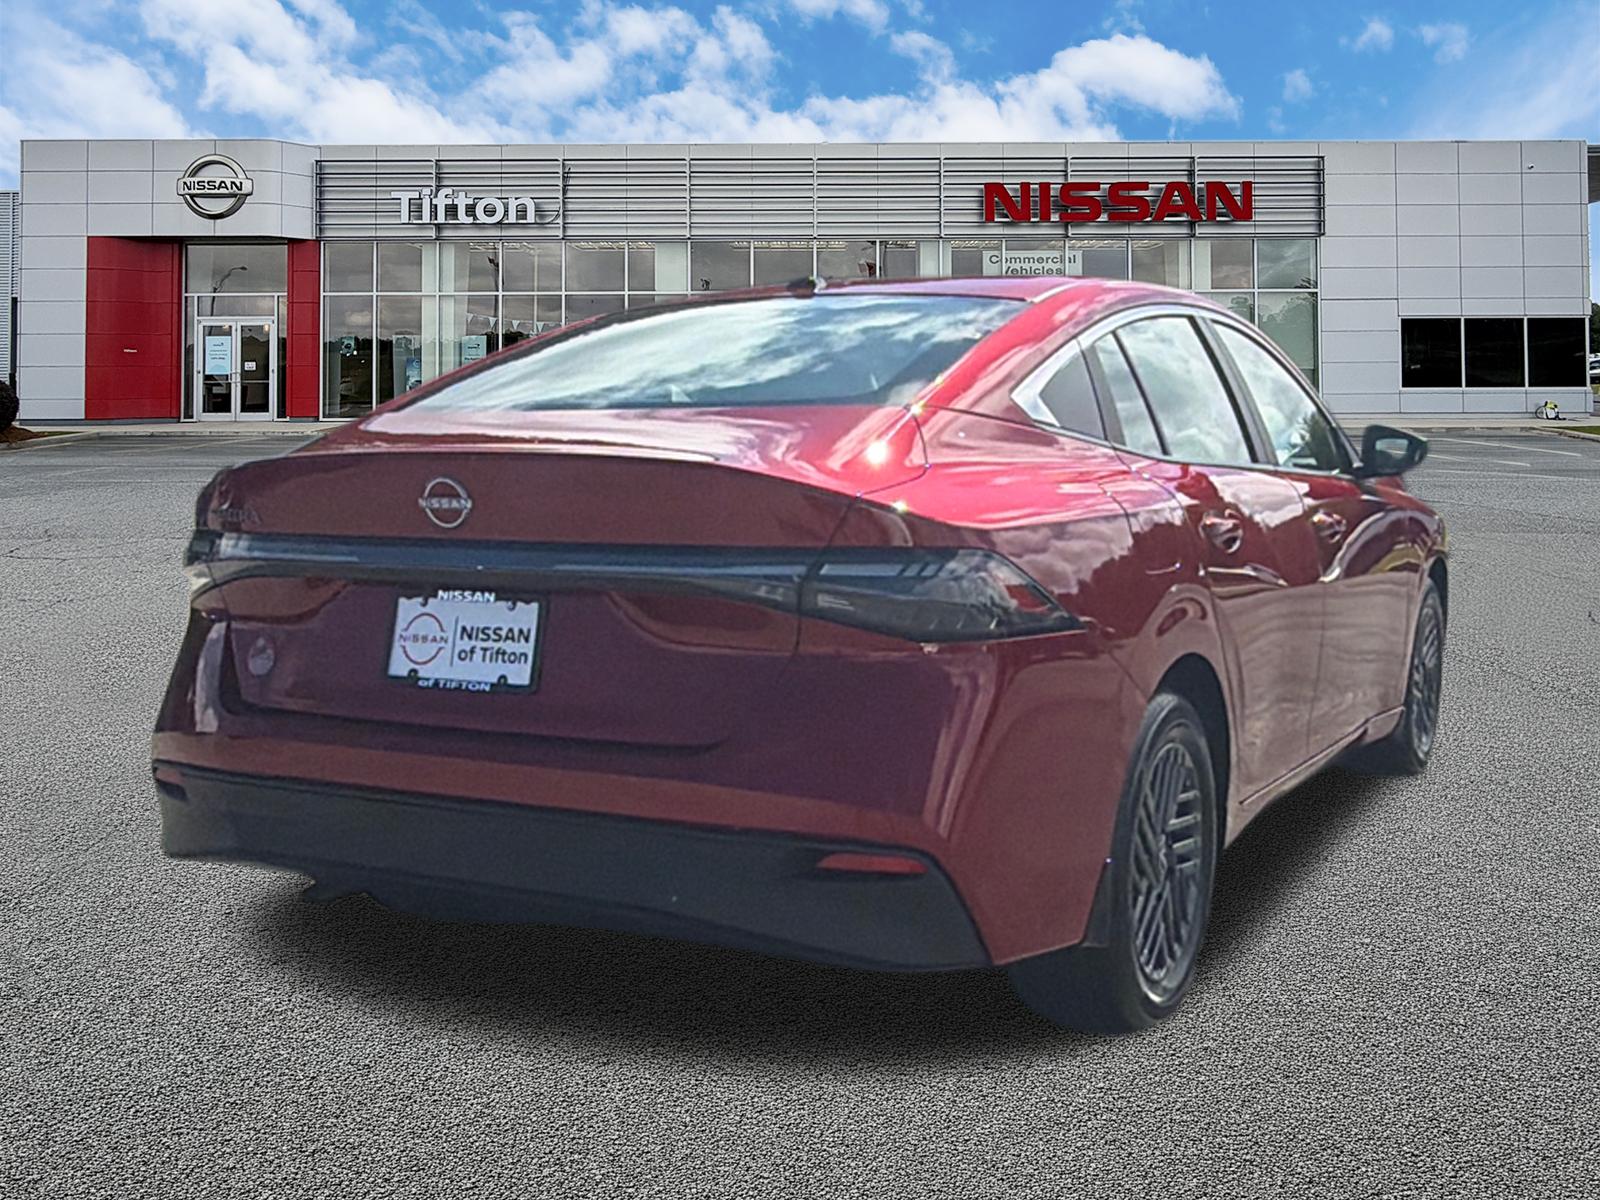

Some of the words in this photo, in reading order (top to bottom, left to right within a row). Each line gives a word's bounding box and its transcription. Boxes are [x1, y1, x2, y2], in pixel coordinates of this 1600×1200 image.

[182, 180, 243, 192] NISSAN
[391, 188, 536, 224] Tifton
[983, 180, 1254, 222] NISSAN
[418, 497, 472, 510] NISSAN
[437, 589, 496, 602] NISSAN
[399, 633, 448, 644] NISSAN
[459, 625, 531, 643] NISSAN
[457, 646, 478, 662] of
[480, 646, 528, 664] Tifton
[417, 678, 435, 687] of
[438, 678, 490, 692] TIFTON
